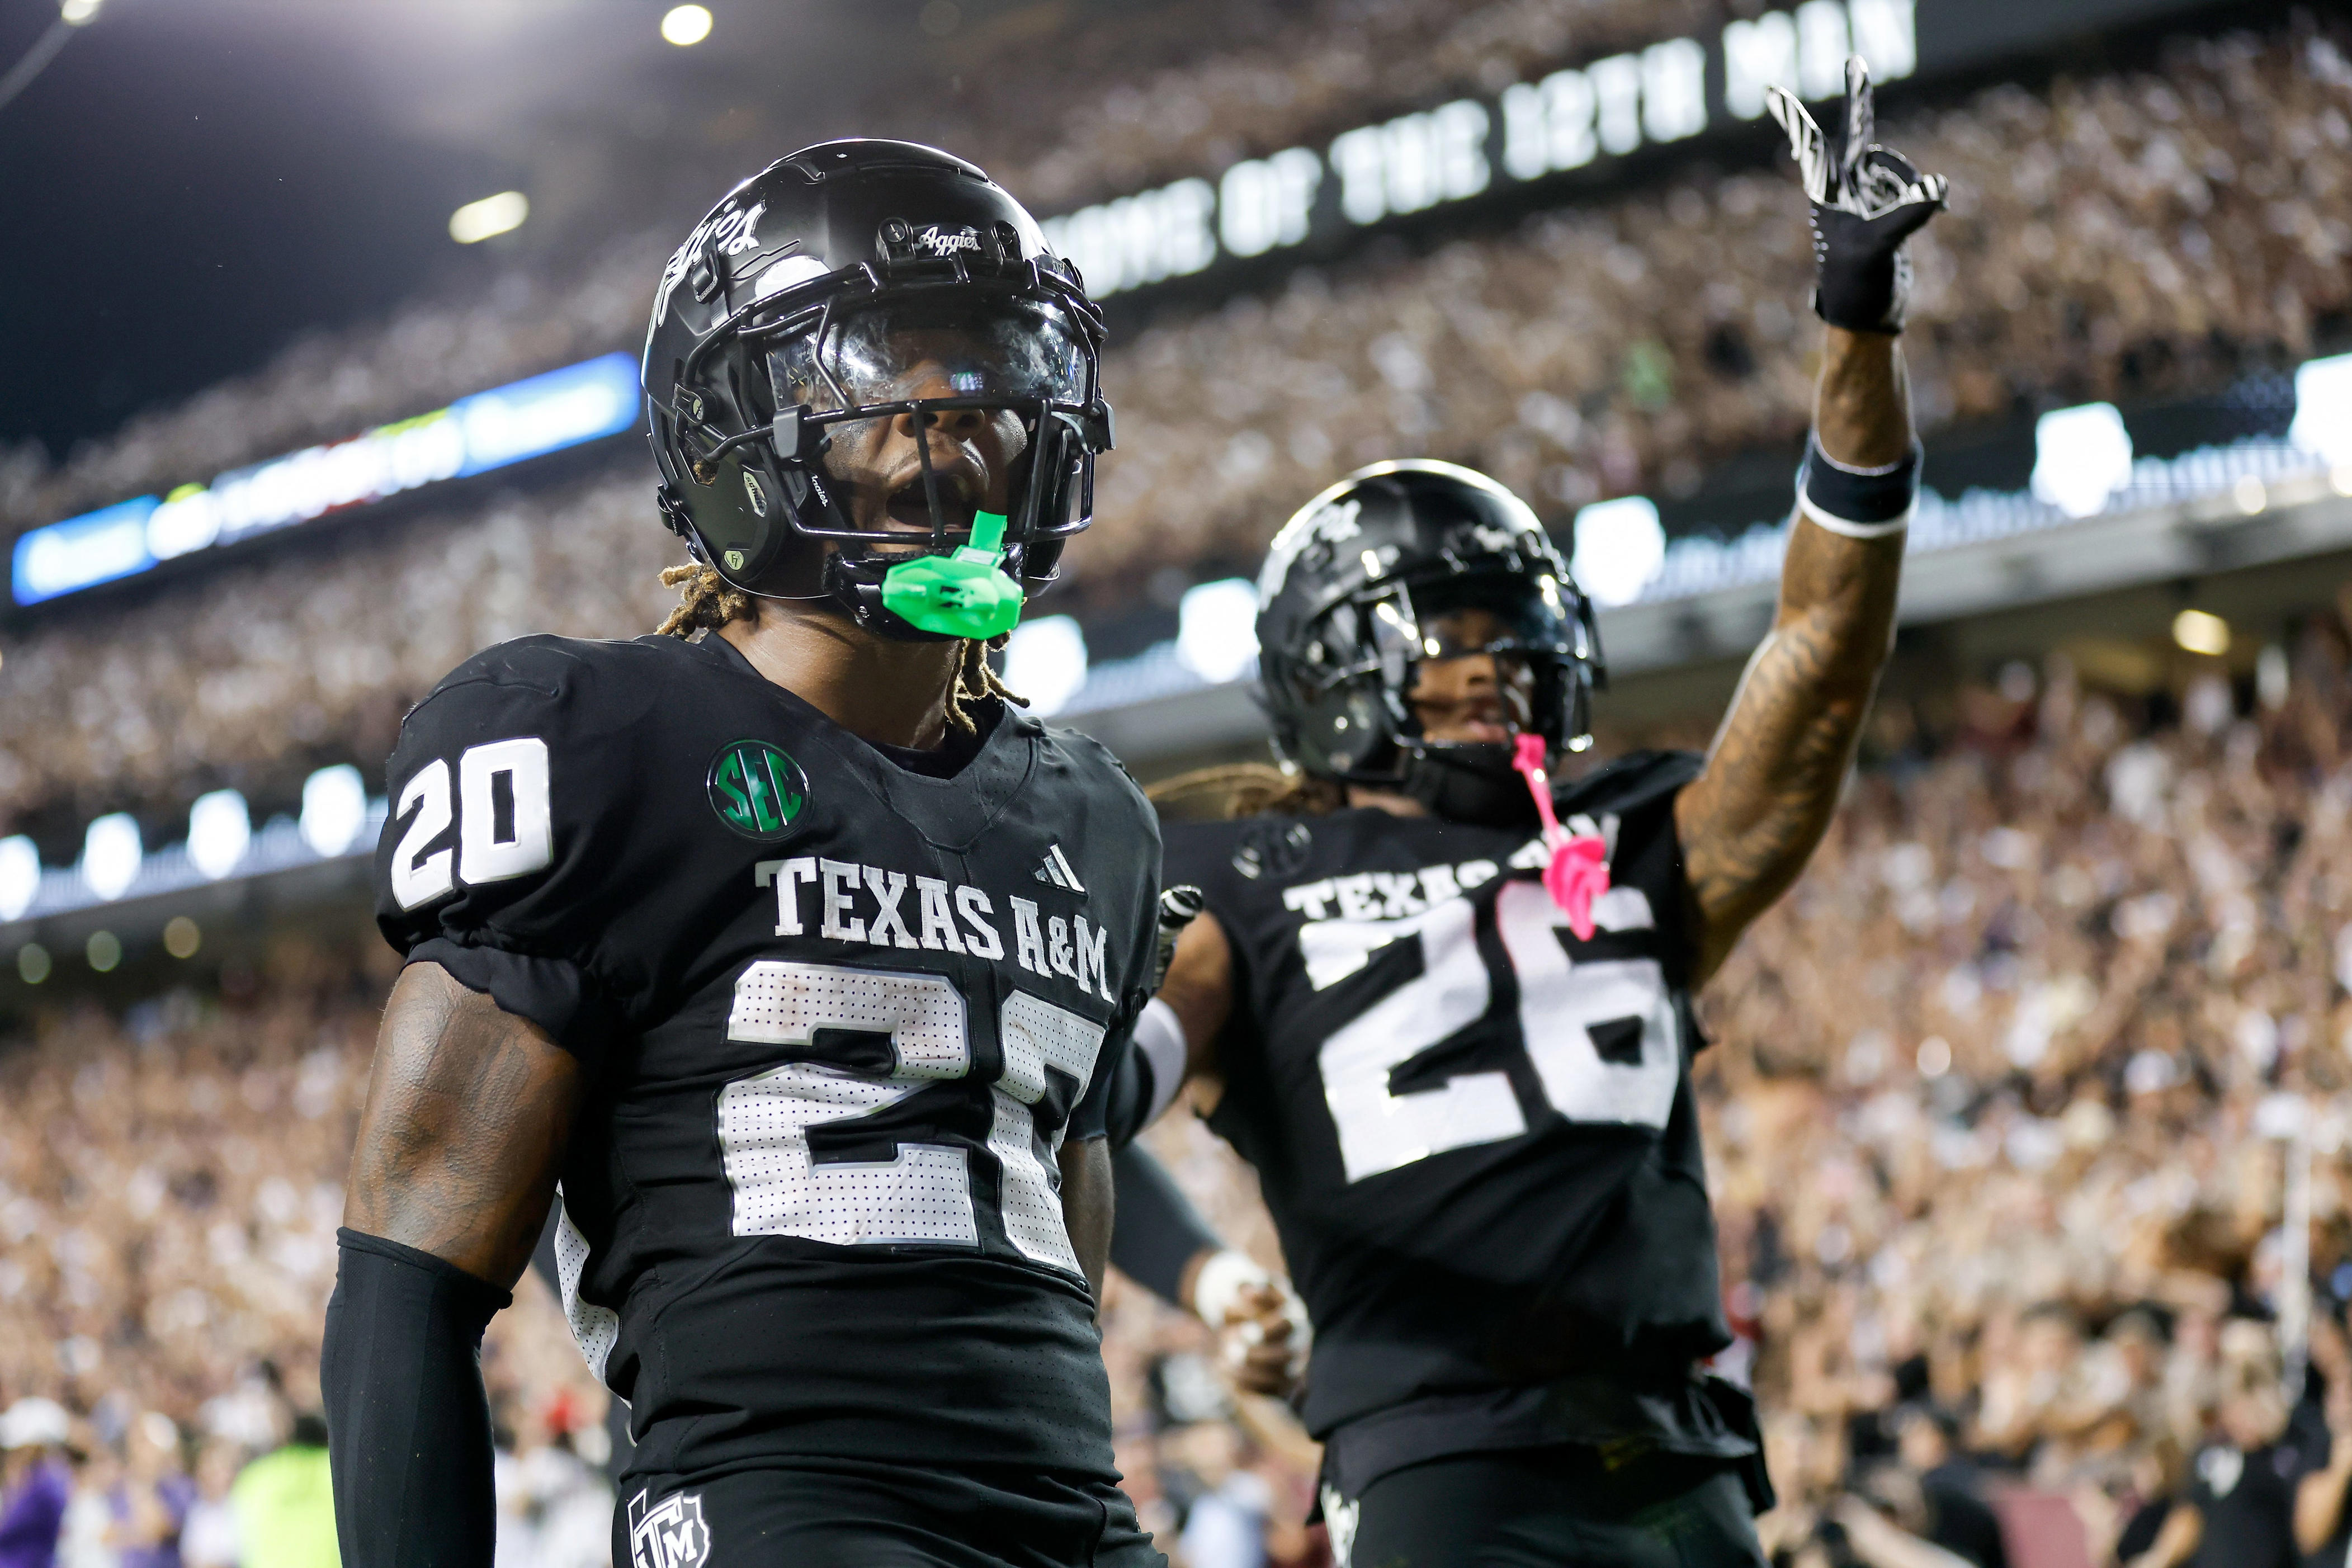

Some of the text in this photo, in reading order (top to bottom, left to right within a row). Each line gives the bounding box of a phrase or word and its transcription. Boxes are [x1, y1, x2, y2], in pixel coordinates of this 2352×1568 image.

[1329, 98, 1492, 225] THE
[914, 226, 982, 256] Aggies
[391, 736, 554, 913] 20
[715, 748, 803, 833] SEC
[755, 857, 1114, 1004] TEXAS A&M
[1298, 879, 1678, 1185] 26
